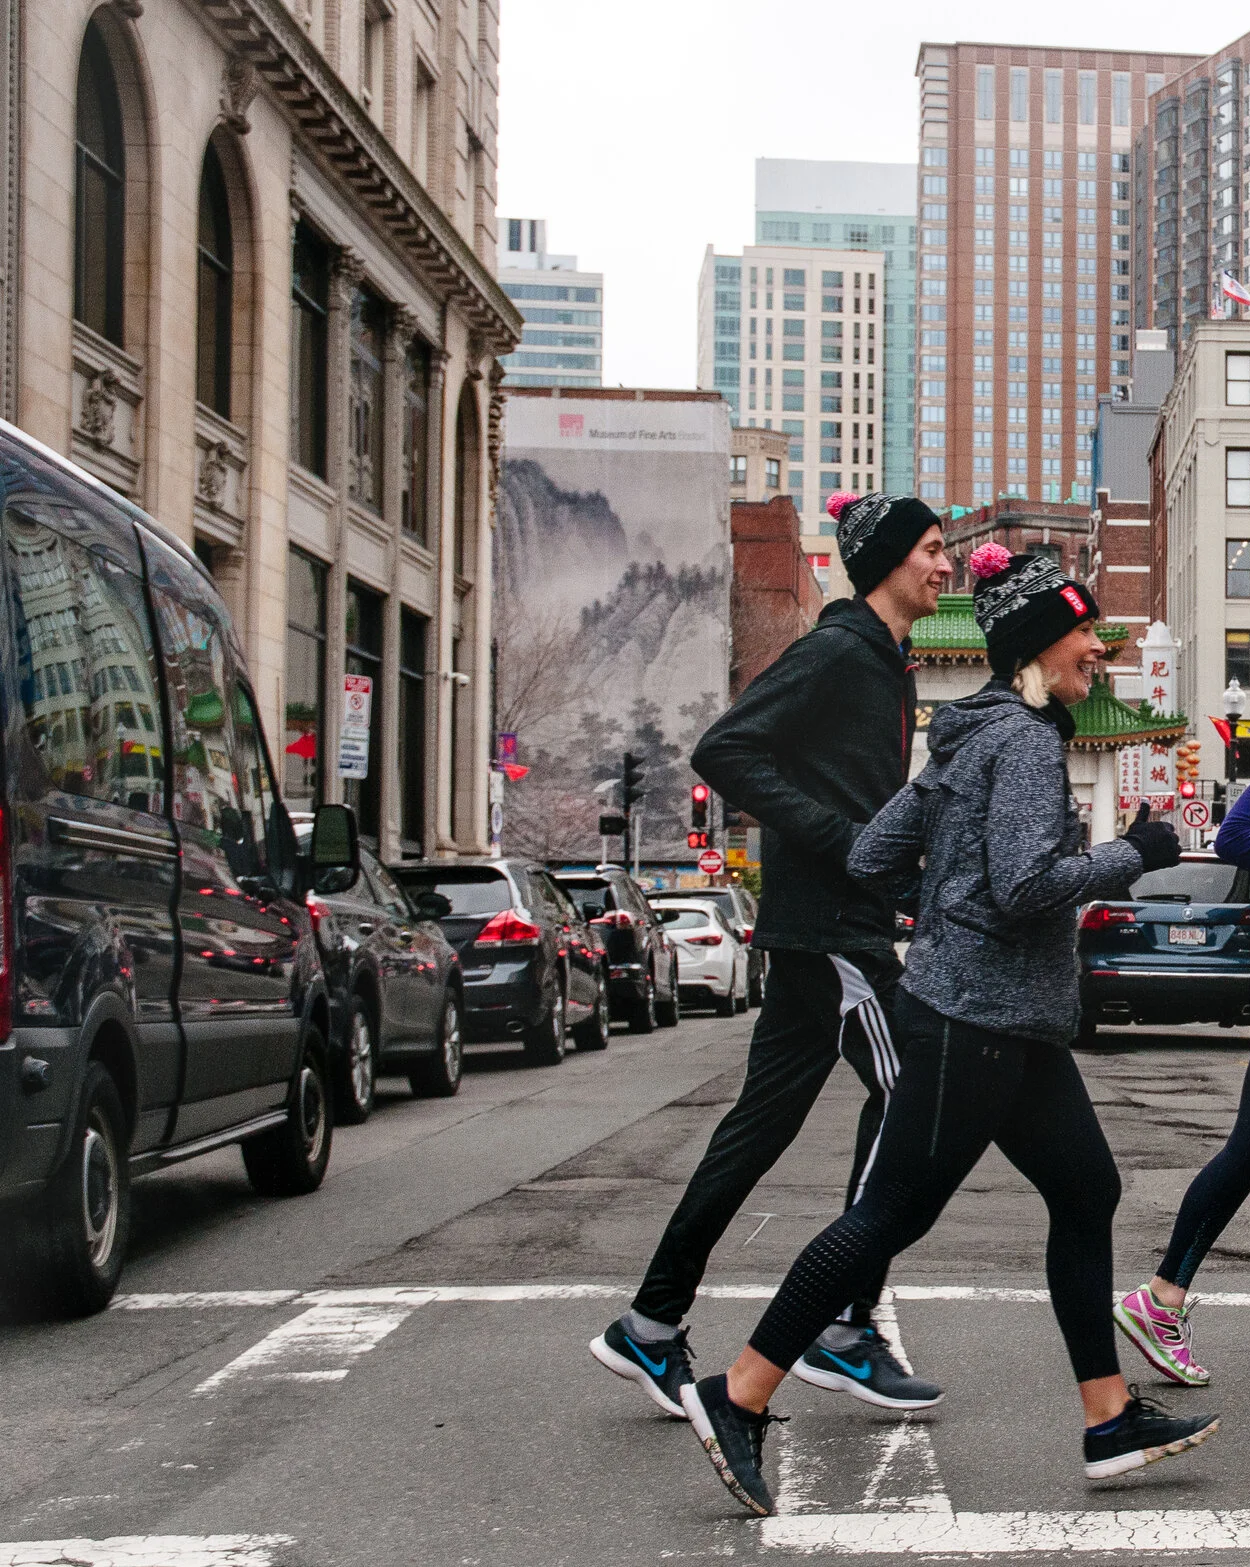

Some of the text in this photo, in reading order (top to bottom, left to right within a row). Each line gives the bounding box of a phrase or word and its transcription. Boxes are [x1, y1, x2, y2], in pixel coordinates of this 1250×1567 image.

[589, 429, 627, 439] Museum
[628, 430, 636, 439] of
[638, 430, 657, 440] Fine
[658, 431, 676, 440] Arts
